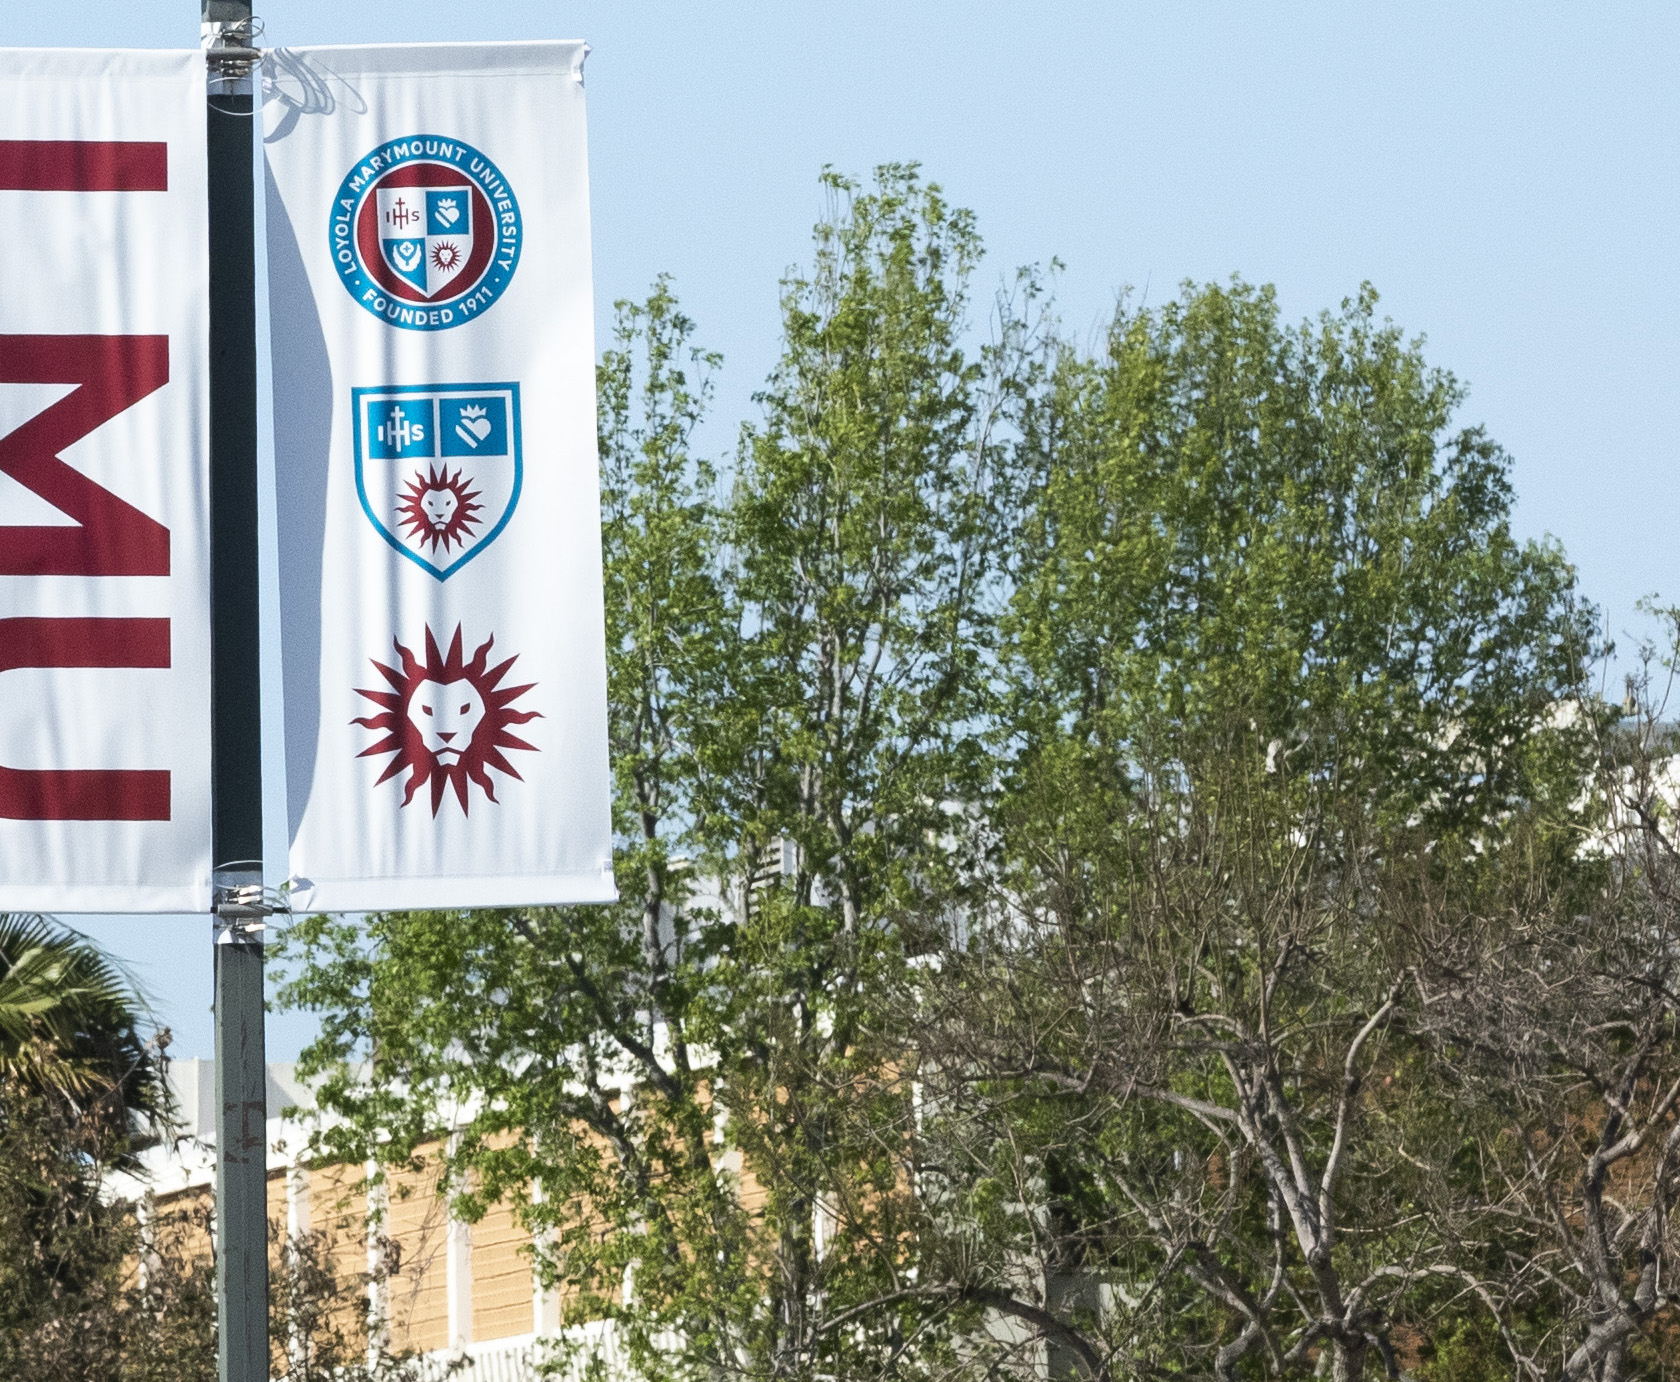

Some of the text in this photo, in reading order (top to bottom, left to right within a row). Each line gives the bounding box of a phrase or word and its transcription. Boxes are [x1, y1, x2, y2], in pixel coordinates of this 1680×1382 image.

[334, 140, 517, 275] LOYOLA MARYMOUNT UNIVERSITY
[362, 285, 493, 326] FOUNDED 1911
